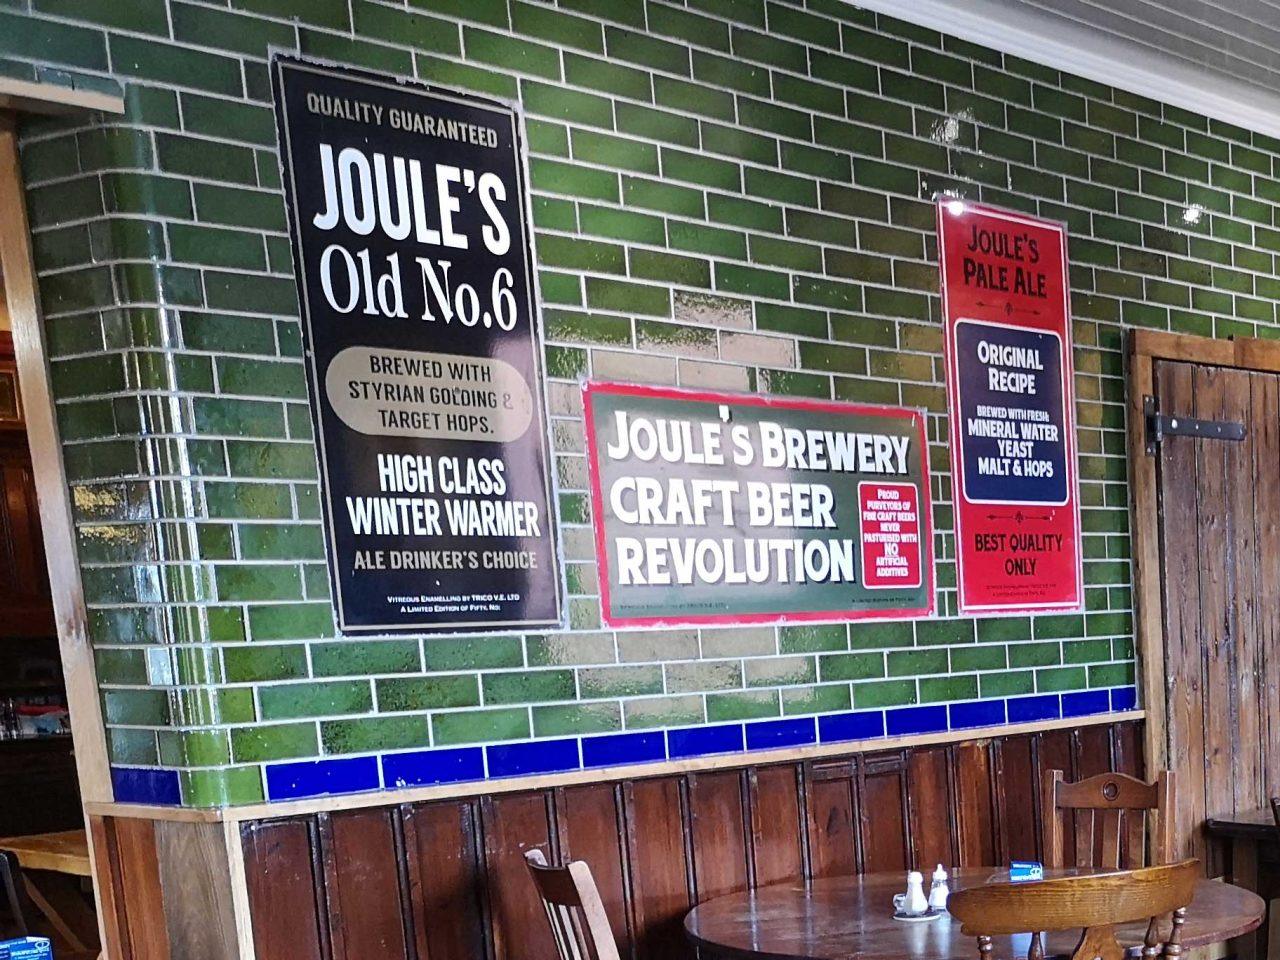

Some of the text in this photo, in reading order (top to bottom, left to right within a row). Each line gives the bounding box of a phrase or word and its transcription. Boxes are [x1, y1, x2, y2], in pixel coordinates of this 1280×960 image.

[307, 92, 498, 148] QUALITY GUARANTEED
[312, 143, 511, 256] JOULE'S
[968, 224, 1039, 264] JOULE'S
[320, 244, 408, 318] Old
[963, 258, 1047, 299] PALE ALE
[370, 354, 491, 382] BREWED WITH
[978, 340, 1043, 370] ORIGINAL
[348, 381, 424, 402] STYRIAN
[430, 387, 497, 408] GOLDING
[988, 368, 1036, 394] RECIPE
[378, 410, 494, 434] TARGET HOPS.
[977, 405, 1007, 419] BREWED
[1008, 408, 1027, 421] WITH
[607, 405, 910, 475] JOULE'S BREWERY
[968, 418, 1059, 442] MINERAL WATER
[998, 441, 1034, 459] YEAST
[378, 454, 506, 496] HIGH CLASS
[978, 457, 1054, 478] MALT & HOPS
[610, 477, 837, 528] CRAFT BEER
[877, 489, 899, 499] PROUD
[346, 496, 541, 537] WINTER WARMER
[877, 512, 897, 521] CRAFT
[884, 543, 899, 556] NO
[975, 534, 1063, 553] BEST QUALITY
[354, 550, 537, 570] ALE DRINKER'S CHOICE
[616, 538, 855, 585] REVOLUTION
[1005, 559, 1037, 576] ONLY
